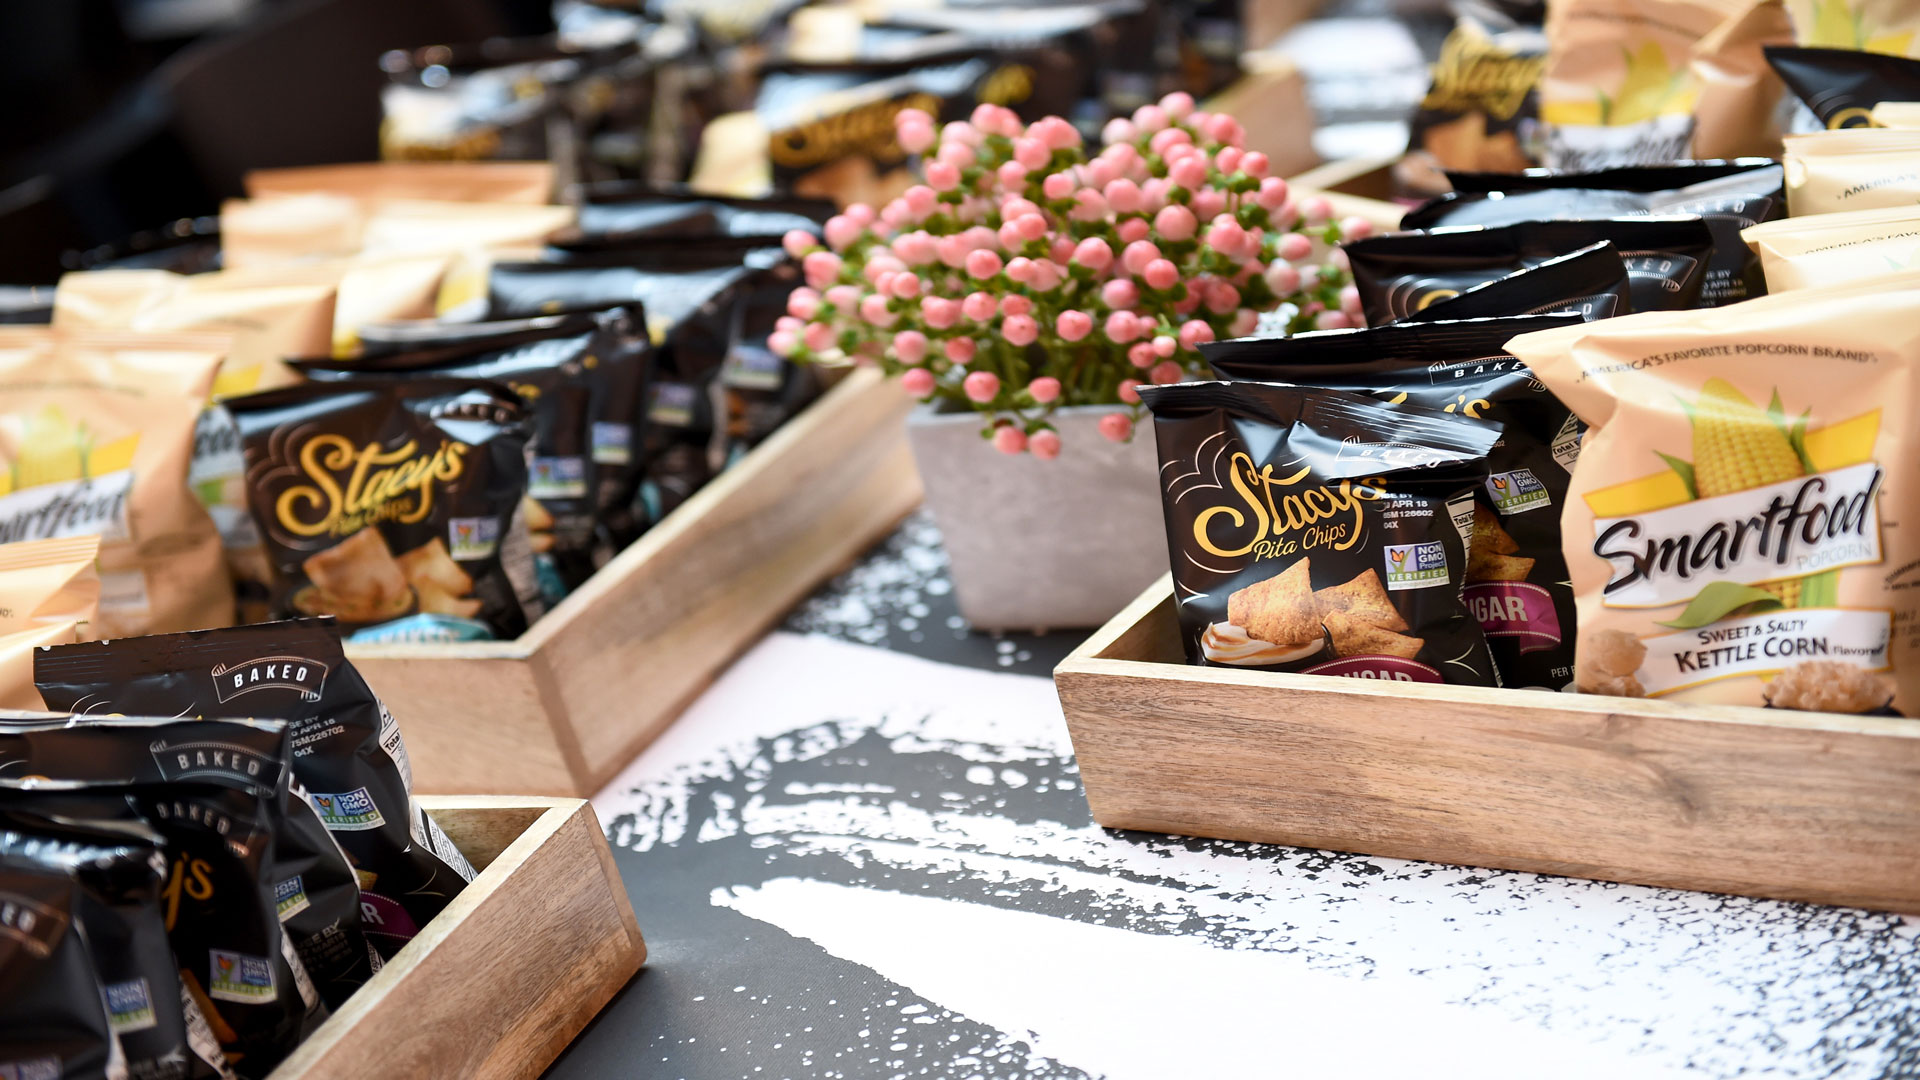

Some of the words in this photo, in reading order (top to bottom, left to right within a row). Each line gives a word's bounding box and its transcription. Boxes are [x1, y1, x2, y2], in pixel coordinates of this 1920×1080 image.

[1625, 258, 1672, 273] KED
[1665, 344, 1730, 363] FAVORITE
[1735, 343, 1809, 357] POPCORN
[1454, 361, 1526, 379] BAKE
[1512, 471, 1531, 481] NON
[1516, 477, 1537, 487] GMO
[276, 433, 470, 537] Stacy's
[1520, 483, 1542, 493] Project
[1192, 451, 1388, 558] Stacy's
[1392, 500, 1414, 509] APR
[1416, 500, 1429, 508] 18
[1496, 491, 1546, 508] VERIFIED
[1593, 467, 1881, 596] Smartfood
[1253, 537, 1298, 562] Pita
[1302, 522, 1347, 551] Chips
[1418, 544, 1442, 555] NON
[1418, 552, 1443, 563] GMO
[1796, 542, 1873, 571] POPCORN
[1420, 559, 1445, 570] Project
[1389, 569, 1446, 582] VERIFIED
[1697, 625, 1752, 645] SWEET
[1754, 625, 1762, 636] &
[1766, 618, 1808, 635] SALTY
[1674, 642, 1758, 673] KETTLE
[1763, 636, 1828, 658] CORN
[233, 664, 308, 688] BAKED
[1551, 666, 1569, 678] PER
[300, 723, 322, 735] APR
[176, 751, 261, 777] BAKED
[338, 789, 366, 804] NON
[341, 798, 369, 811] GMO
[156, 802, 232, 836] BAKED
[325, 812, 378, 824] VERIFIED
